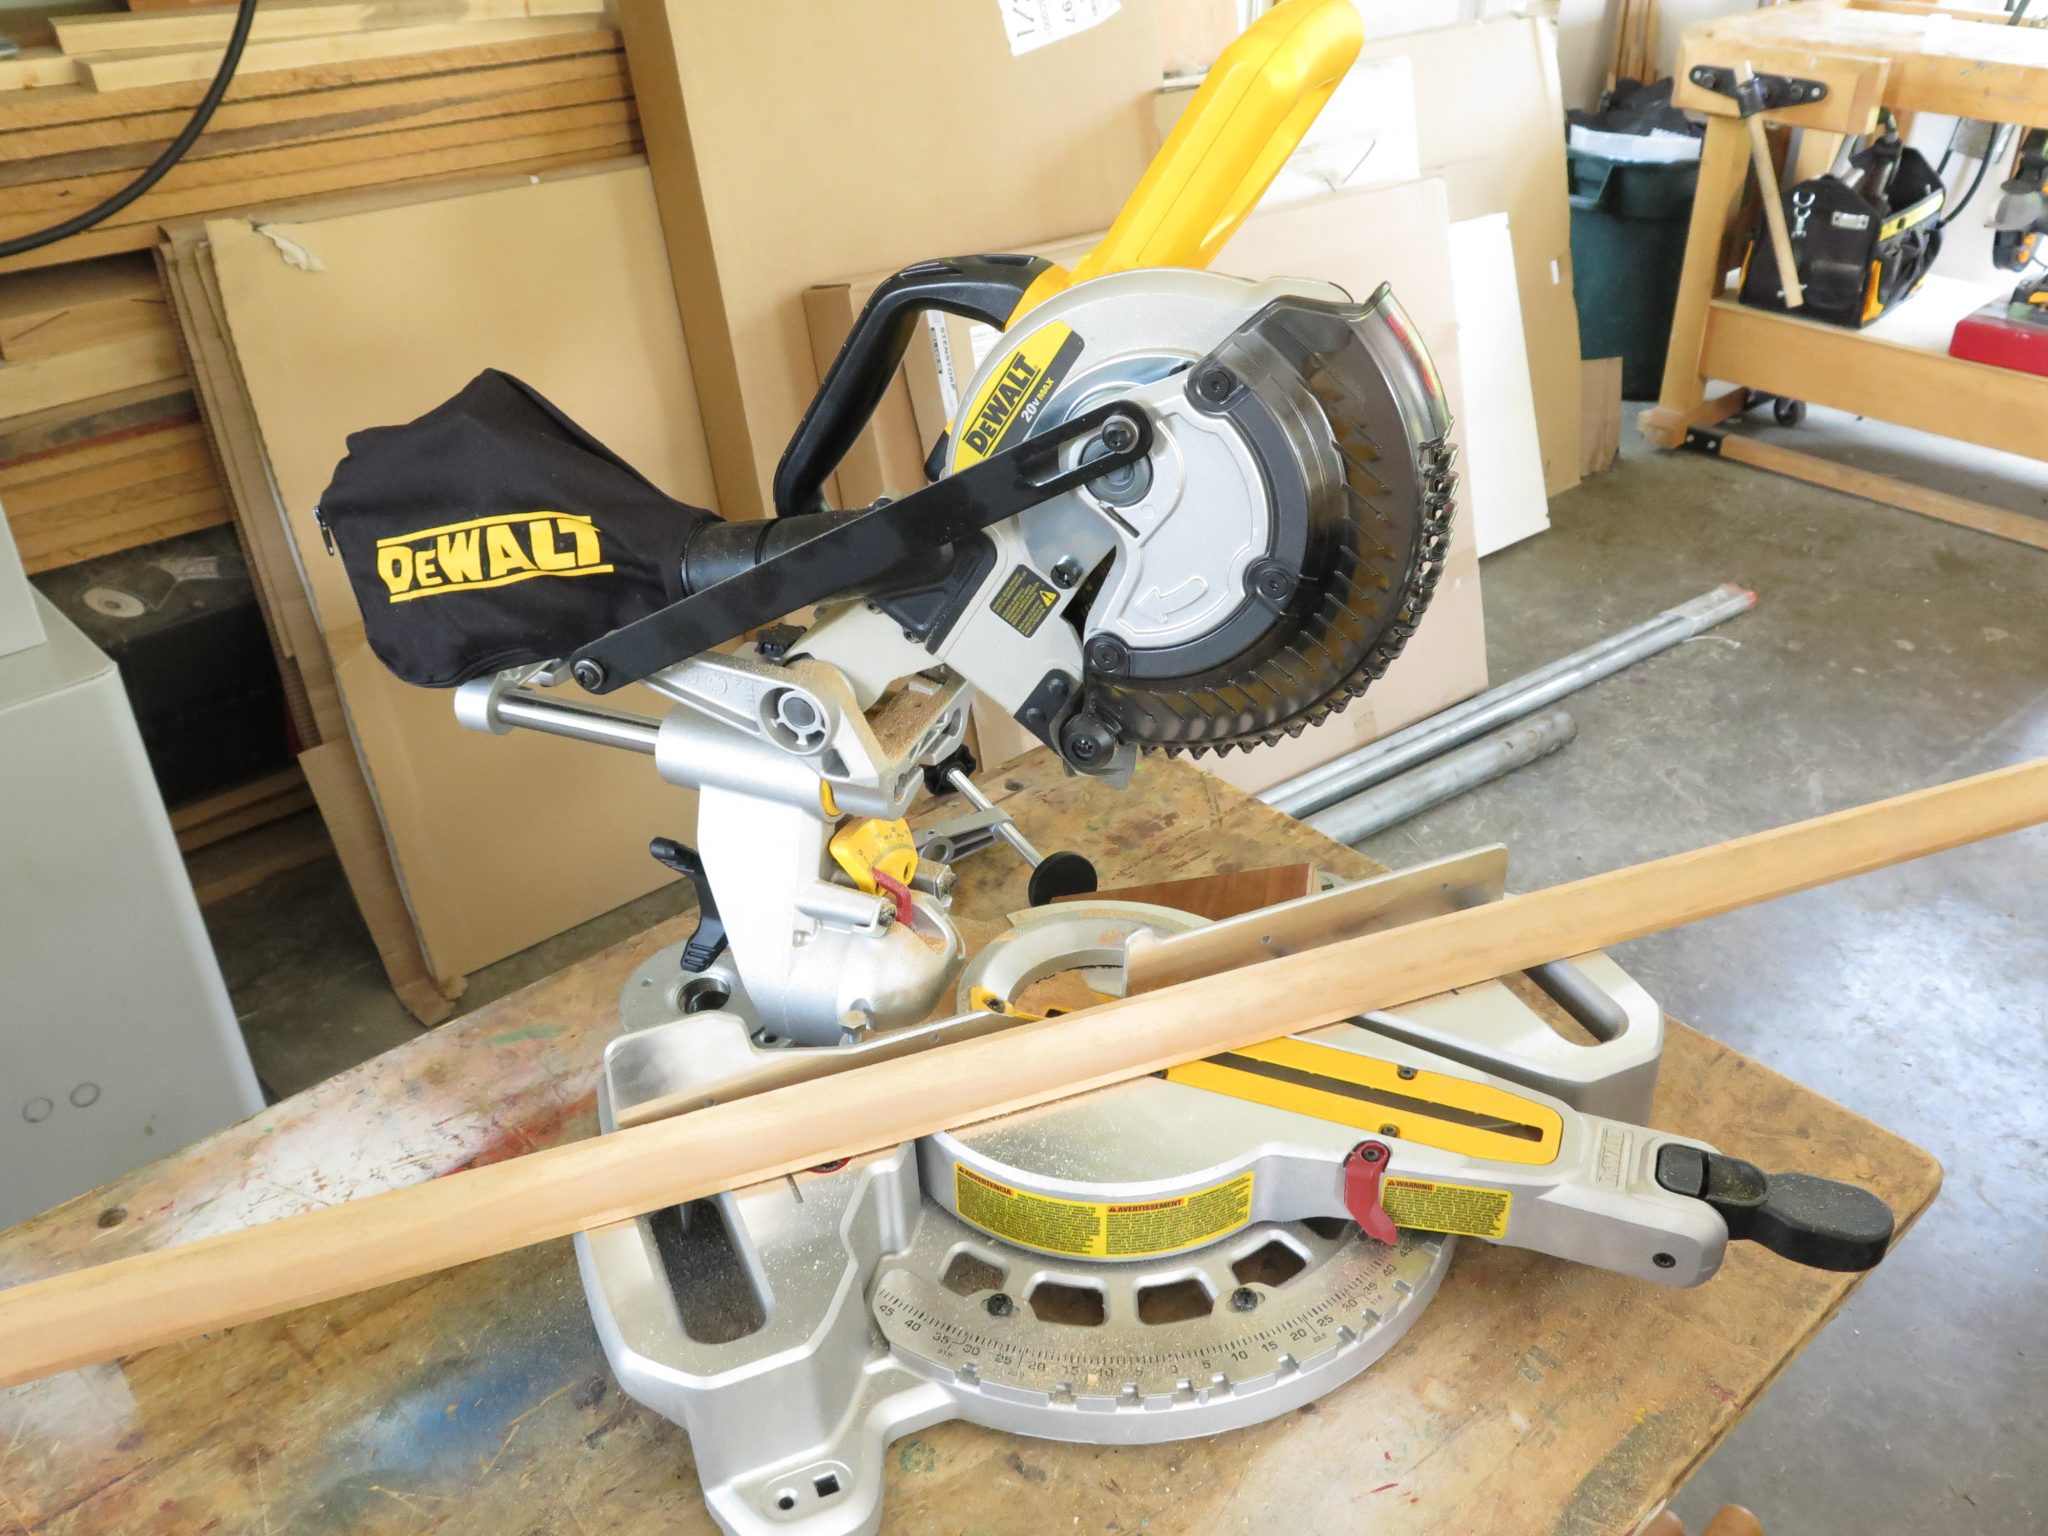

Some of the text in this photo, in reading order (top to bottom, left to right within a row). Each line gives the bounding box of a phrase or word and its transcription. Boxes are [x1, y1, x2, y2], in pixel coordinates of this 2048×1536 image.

[940, 326, 957, 391] STENSTORP
[1036, 376, 1055, 401] MAX
[965, 353, 1037, 455] DEWALT
[376, 517, 602, 595] DEWALT
[1117, 1199, 1181, 1213] AVERTISSEMENT
[1396, 1180, 1433, 1191] WARNING
[879, 1304, 896, 1317] 45
[904, 1318, 922, 1332] 40
[932, 1331, 950, 1345] 35
[962, 1343, 981, 1356] 30
[1028, 1360, 1046, 1372] 20
[1202, 1358, 1212, 1370] 5
[1230, 1349, 1249, 1362] 10
[1261, 1340, 1279, 1353] 15
[1289, 1328, 1308, 1342] 20
[1316, 1314, 1334, 1328] 25
[1341, 1299, 1358, 1312] 30
[1362, 1281, 1378, 1295] 35
[1382, 1263, 1398, 1278] 40
[1400, 1247, 1413, 1259] 45
